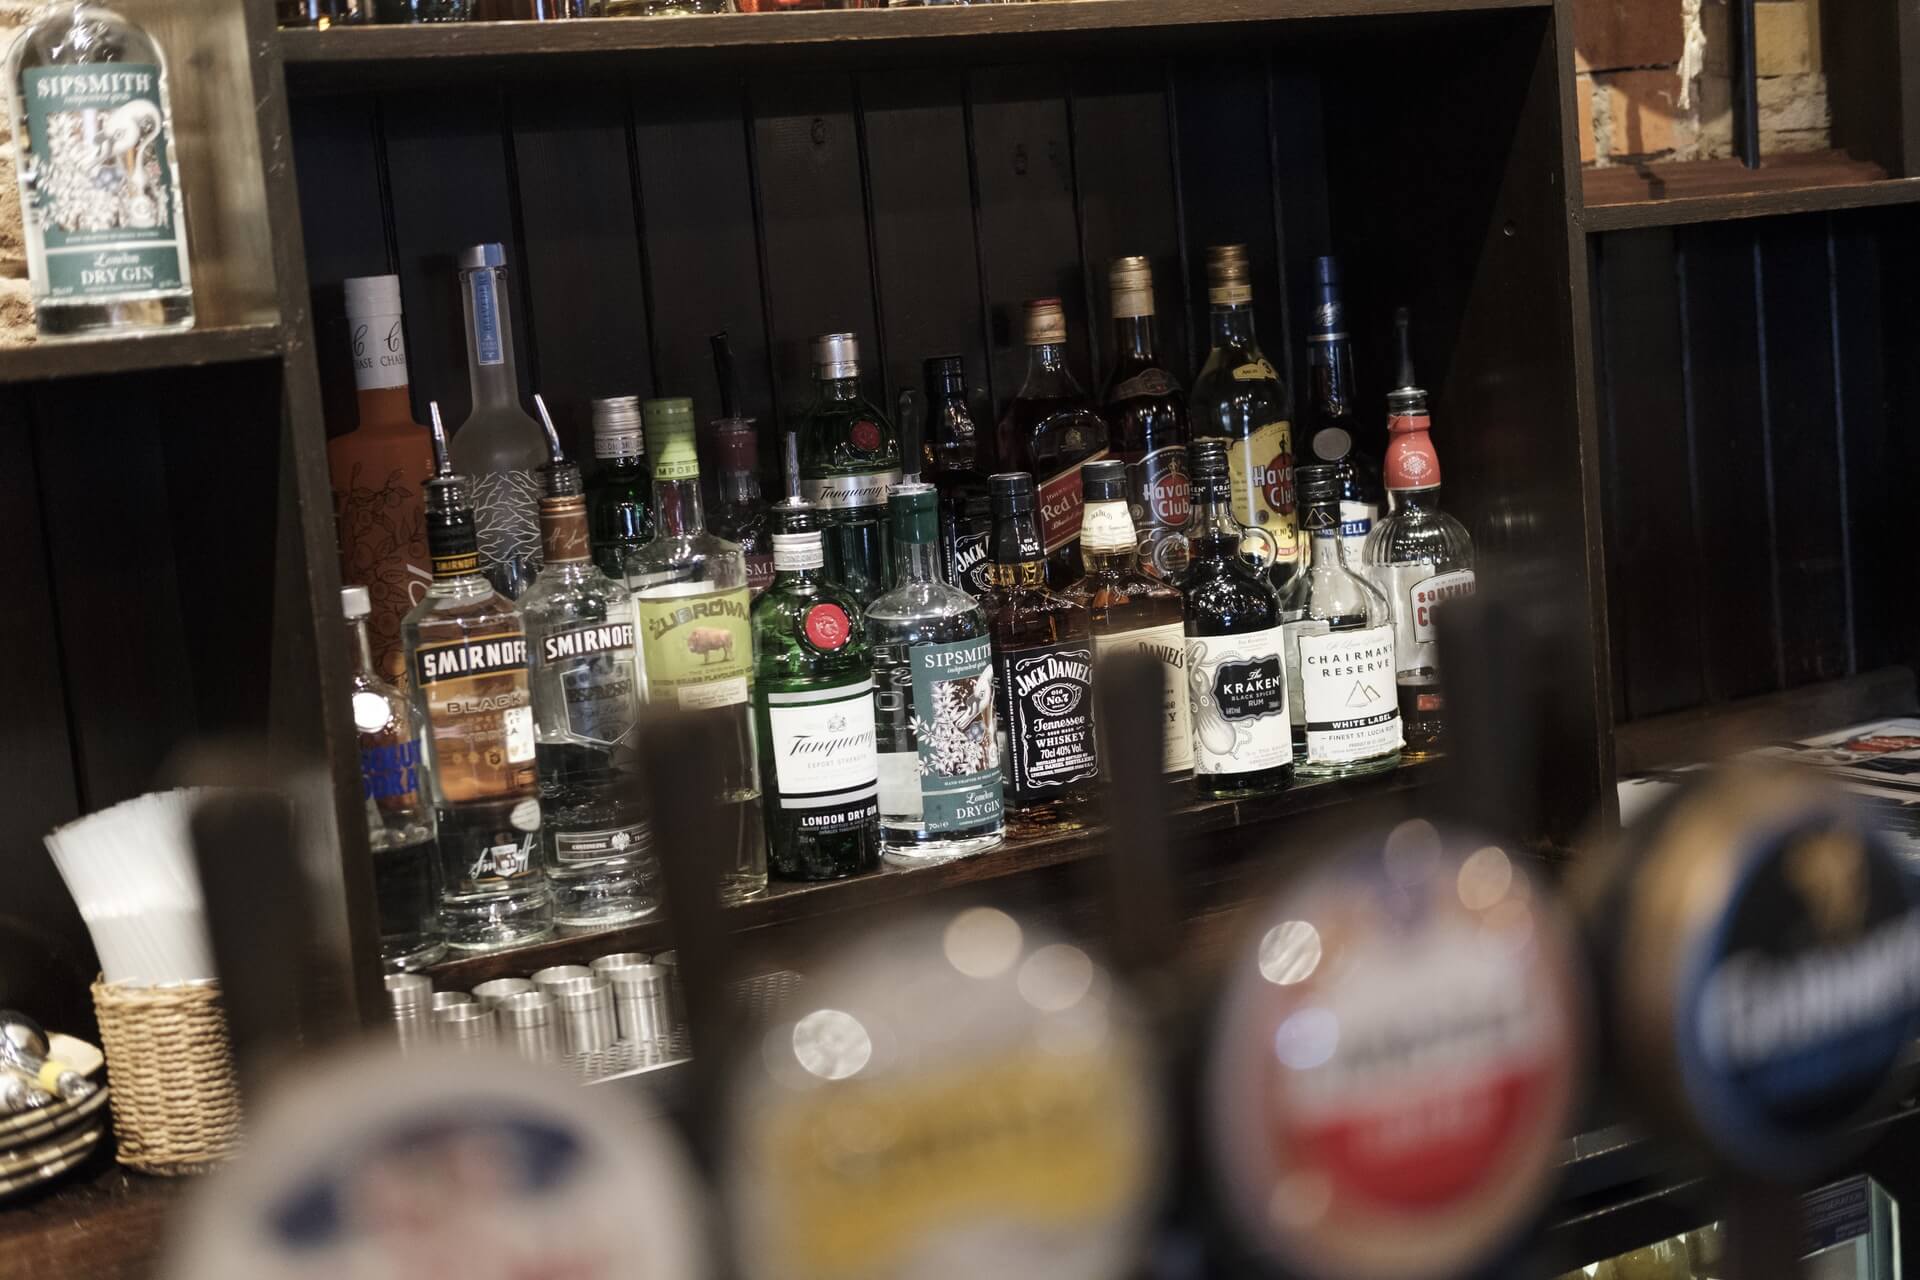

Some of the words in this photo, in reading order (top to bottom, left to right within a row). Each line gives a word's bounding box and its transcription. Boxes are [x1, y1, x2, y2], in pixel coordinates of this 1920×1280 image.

[36, 72, 152, 98] SIPSMITH
[80, 266, 118, 285] DRY
[121, 264, 155, 281] GIN
[380, 353, 406, 367] CHAS
[820, 485, 884, 501] Tanqueray
[1040, 495, 1072, 521] Red
[1158, 500, 1189, 517] Club
[1020, 541, 1040, 553] No.7
[955, 542, 987, 574] JACK
[545, 625, 633, 660] SMIRNOFF
[424, 640, 528, 677] SMIRNOFF
[1138, 641, 1184, 669] DANIEL'S
[1307, 642, 1392, 664] CHAIRMAN'S
[1246, 668, 1262, 681] The
[1322, 658, 1389, 677] RESERVE
[1015, 664, 1049, 697] JACK
[1047, 657, 1093, 685] DANIEL'S
[1223, 678, 1281, 695] KRAKEN
[447, 692, 521, 715] BLACK
[1046, 693, 1069, 705] No.7
[1231, 693, 1253, 702] BLACK
[1248, 699, 1264, 707] RUM
[1033, 715, 1085, 732] Tennessee
[1332, 719, 1366, 729] WHITE
[1368, 713, 1392, 724] LABEL
[789, 730, 874, 757] Tanqueray
[1036, 731, 1085, 748] WHISKEY
[1329, 733, 1354, 741] FINEST
[1041, 748, 1056, 759] 70cl
[1056, 745, 1071, 756] 40%
[802, 813, 845, 827] LONDON
[847, 808, 865, 822] DRY
[866, 804, 877, 816] GIN
[956, 804, 982, 819] DRY
[984, 798, 1000, 814] GIN
